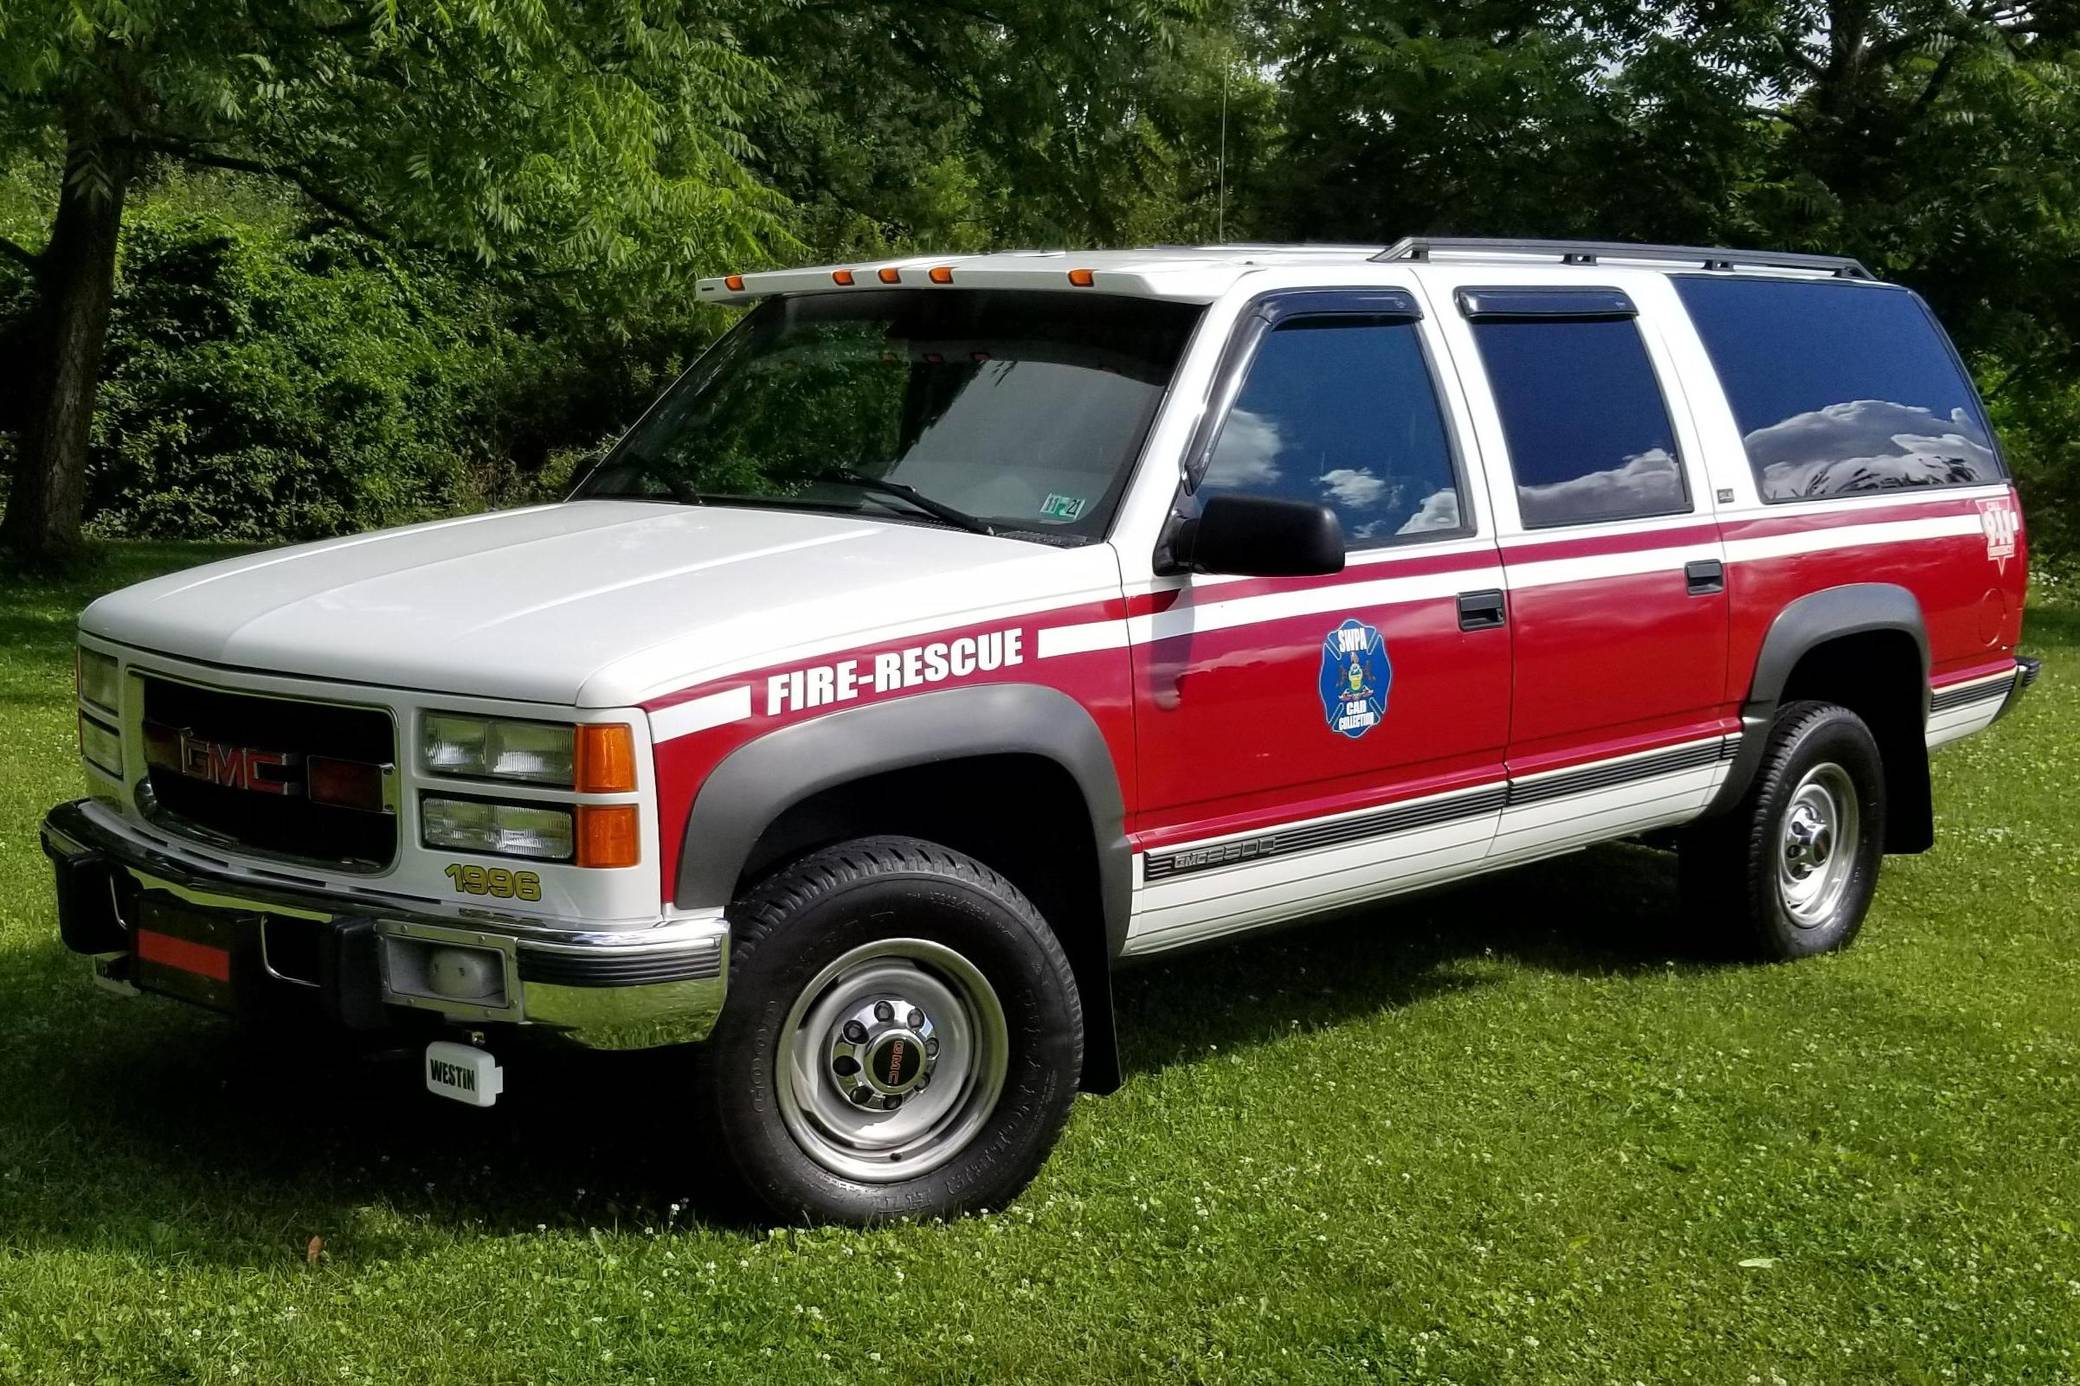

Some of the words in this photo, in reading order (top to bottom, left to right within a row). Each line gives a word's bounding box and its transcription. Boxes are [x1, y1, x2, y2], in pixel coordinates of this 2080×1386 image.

[1337, 626, 1369, 653] SWPA
[767, 627, 1024, 717] FIRE-RESCUE
[1346, 699, 1367, 716] CAR
[179, 730, 296, 797] GMC
[444, 863, 543, 902] 1996
[887, 1040, 905, 1085] GMC
